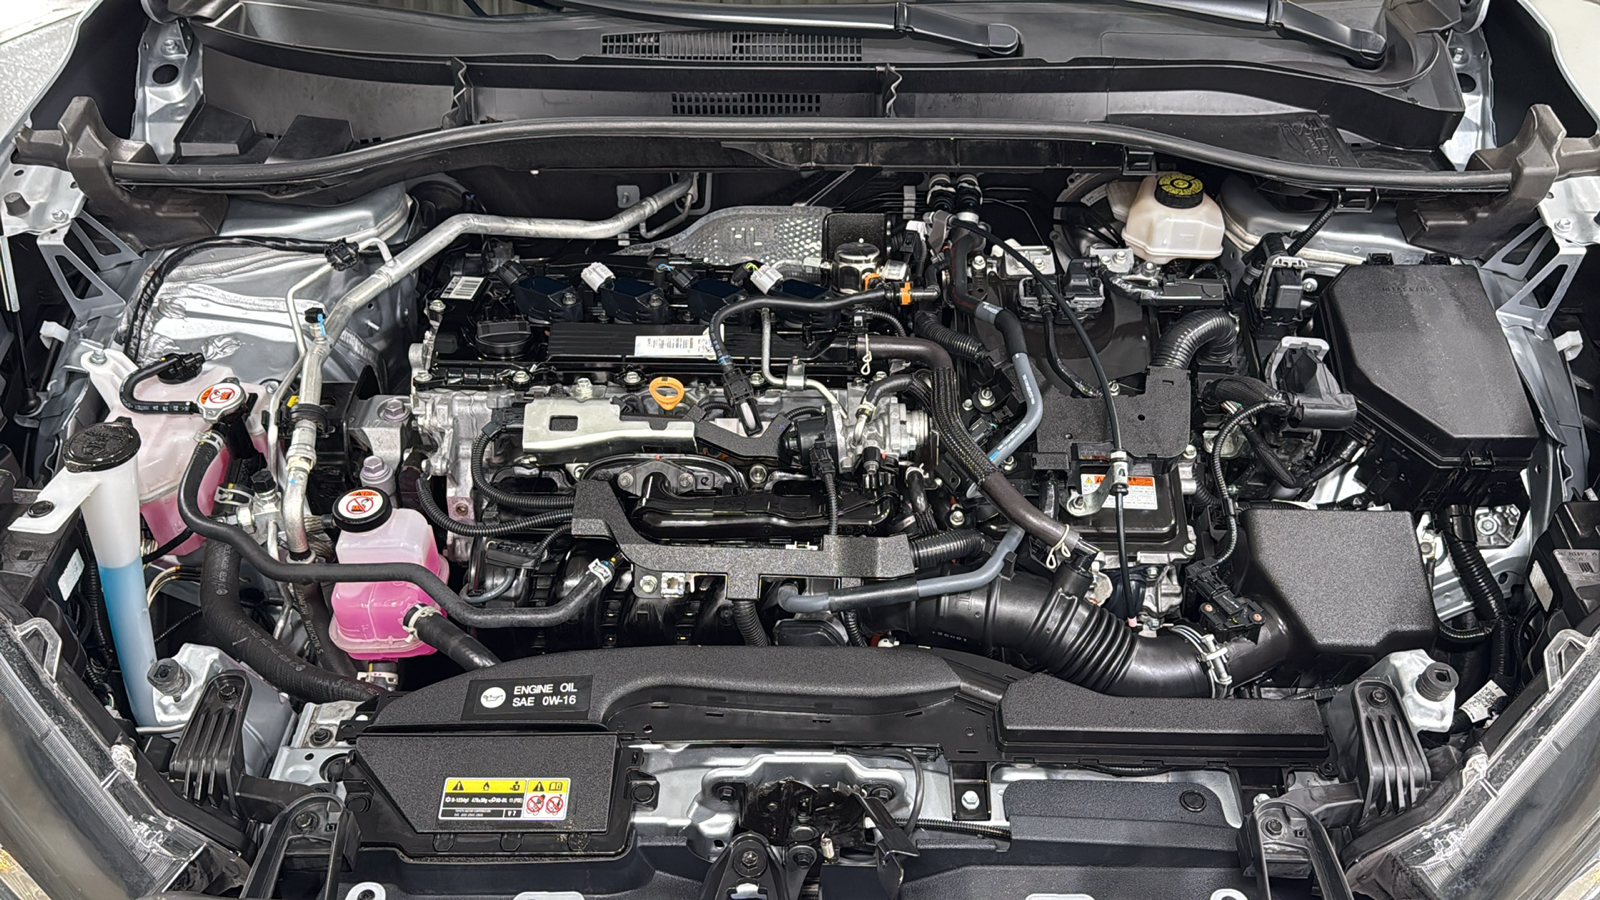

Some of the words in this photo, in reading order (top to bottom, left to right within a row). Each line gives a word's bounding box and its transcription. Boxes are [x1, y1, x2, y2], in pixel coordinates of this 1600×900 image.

[513, 683, 554, 695] ENGINE
[559, 682, 578, 693] OIL
[512, 696, 535, 707] SAE
[542, 695, 577, 706] 0W-16
